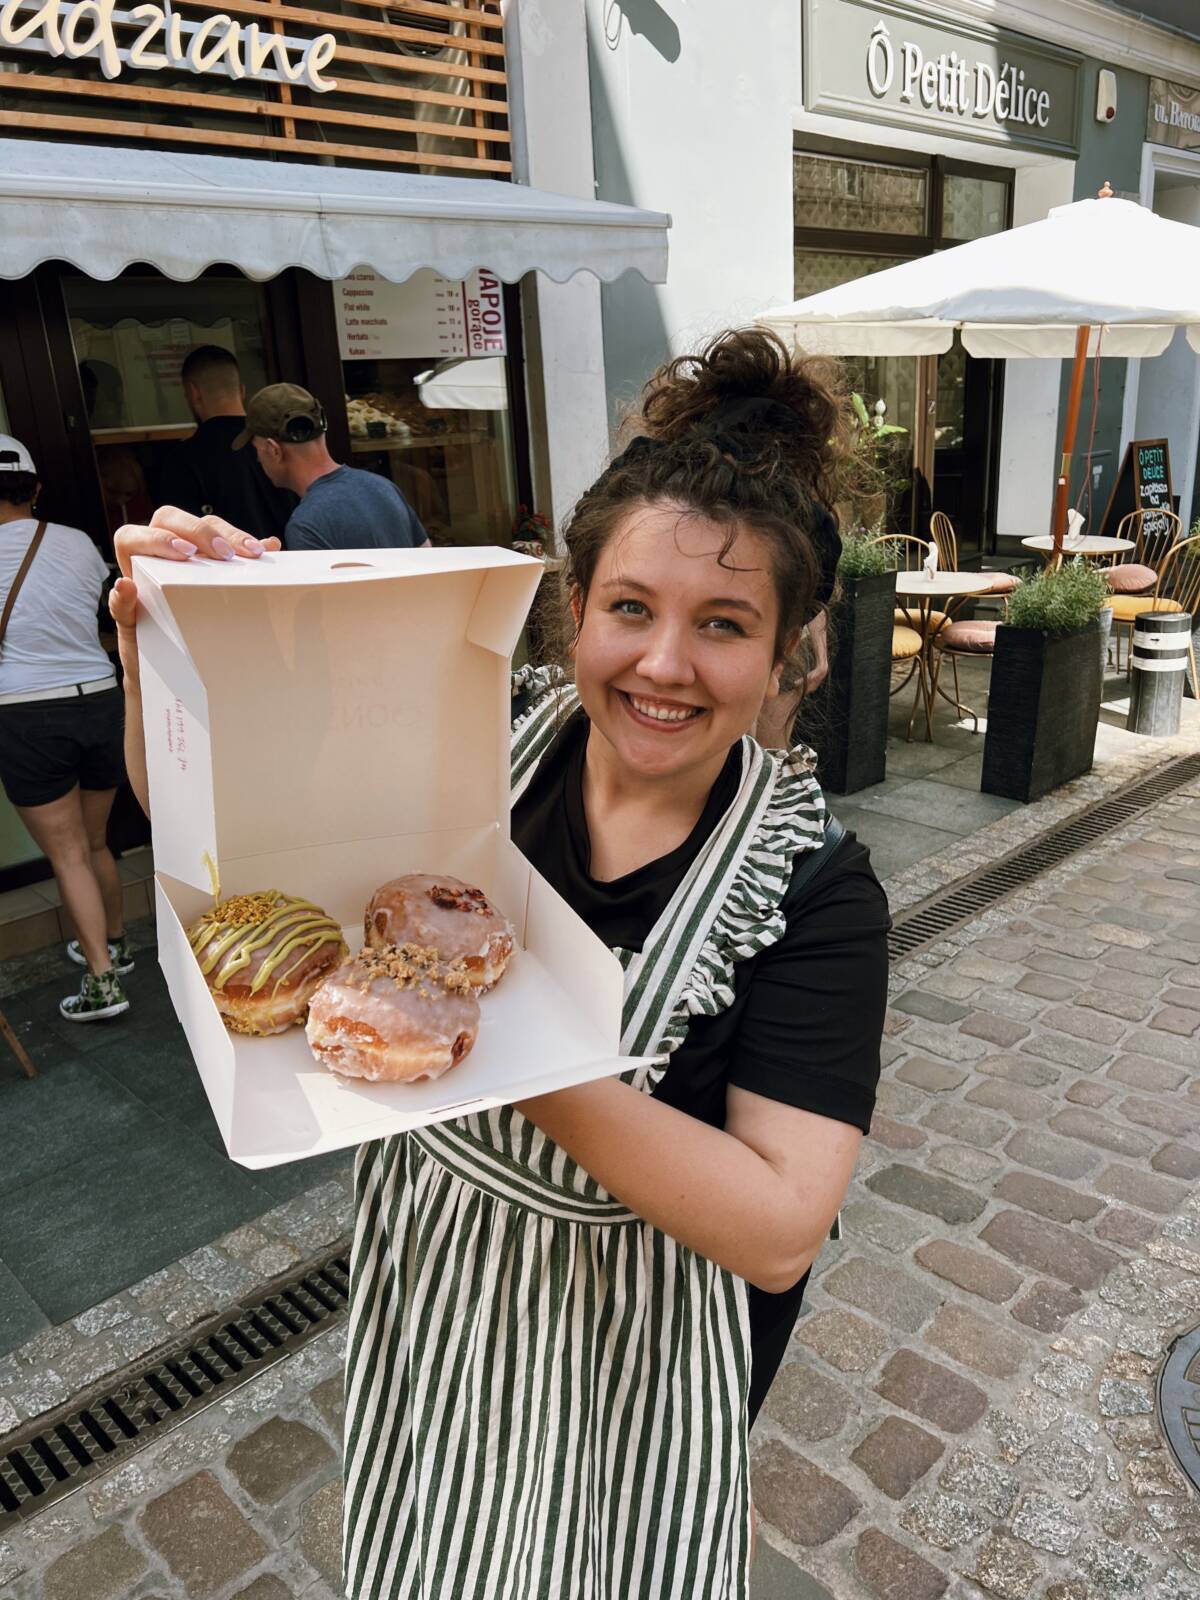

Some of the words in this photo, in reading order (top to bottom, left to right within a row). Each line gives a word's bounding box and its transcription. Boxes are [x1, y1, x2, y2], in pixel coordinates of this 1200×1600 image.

[868, 19, 894, 95] Ô
[902, 41, 970, 111] Petit
[974, 61, 1050, 127] Délice
[342, 287, 374, 298] Cappuccino
[478, 268, 503, 352] APOJE
[345, 318, 359, 326] Latte
[361, 318, 388, 326] macchiato
[467, 298, 483, 350] gorące
